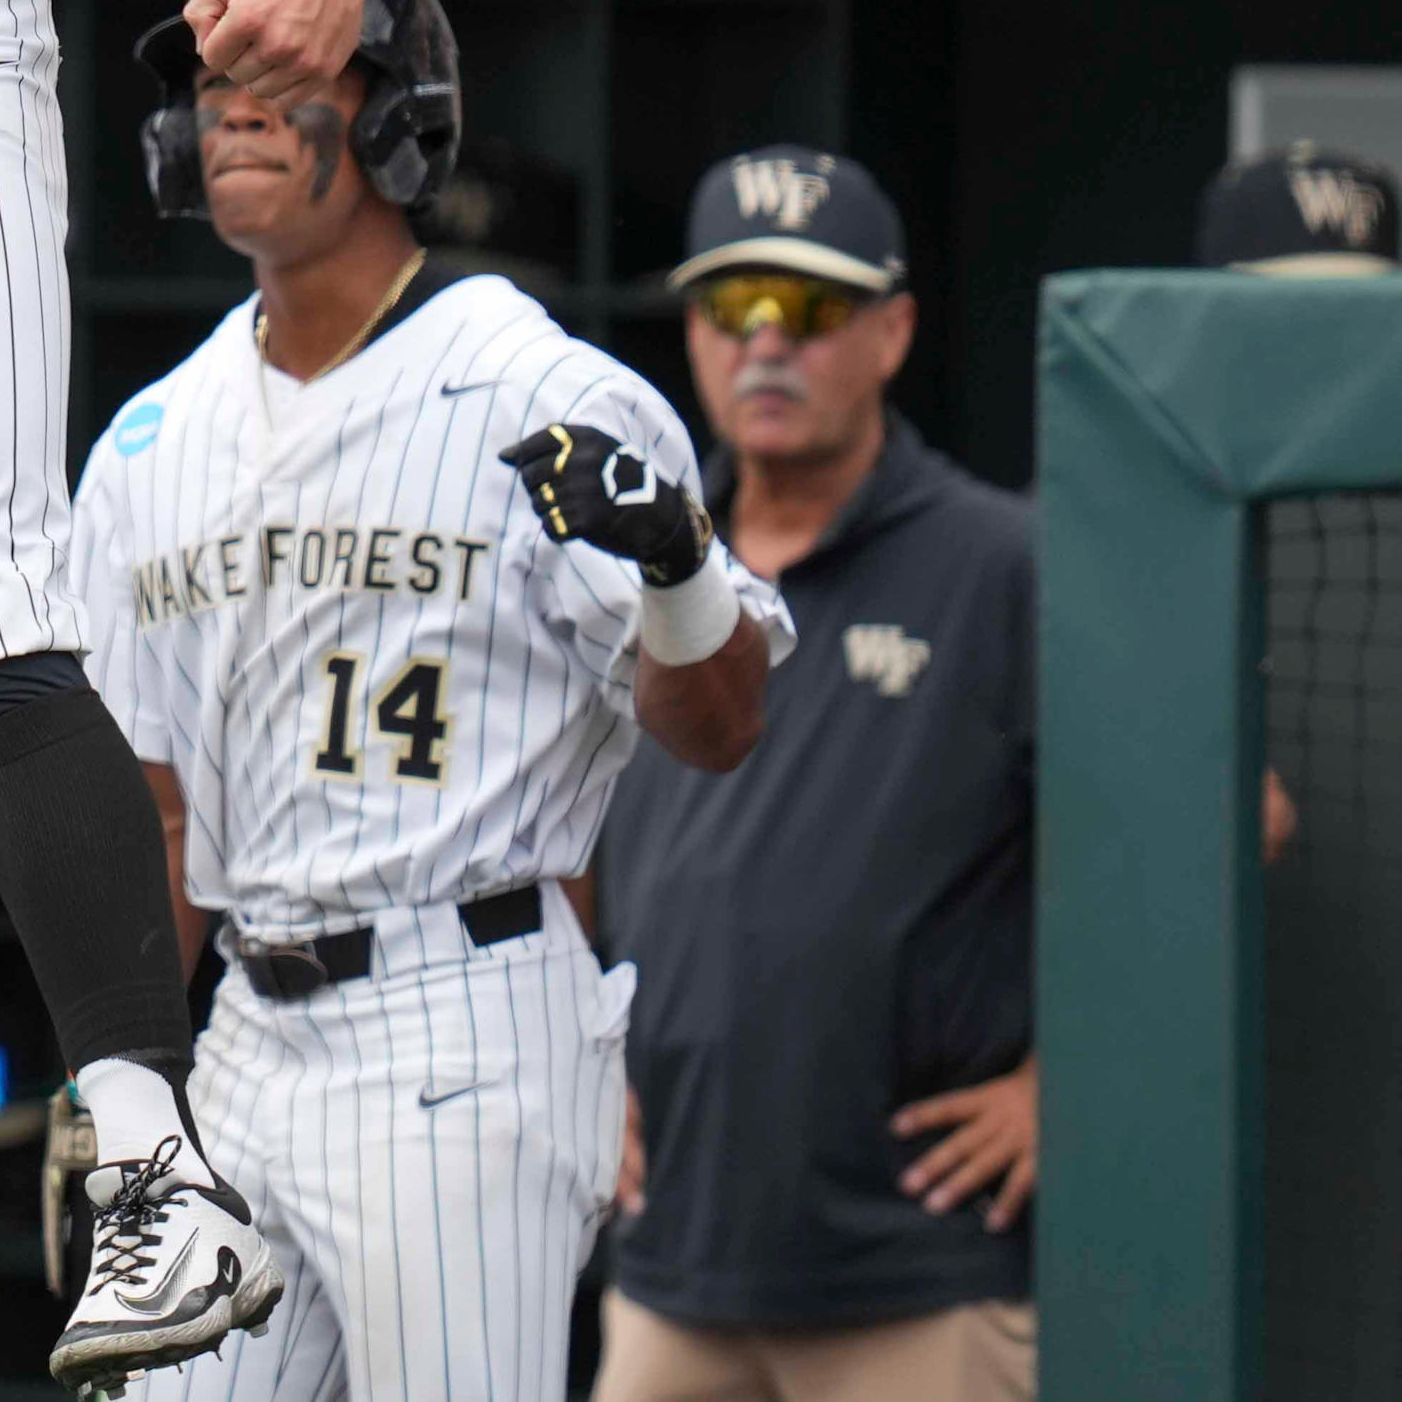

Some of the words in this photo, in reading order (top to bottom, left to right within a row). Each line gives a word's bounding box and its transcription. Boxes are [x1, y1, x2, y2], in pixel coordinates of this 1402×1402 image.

[733, 155, 832, 232] WF
[131, 532, 248, 630] WAKE
[259, 522, 492, 602] FOREST
[841, 623, 932, 698] WF
[312, 648, 452, 788] 14
